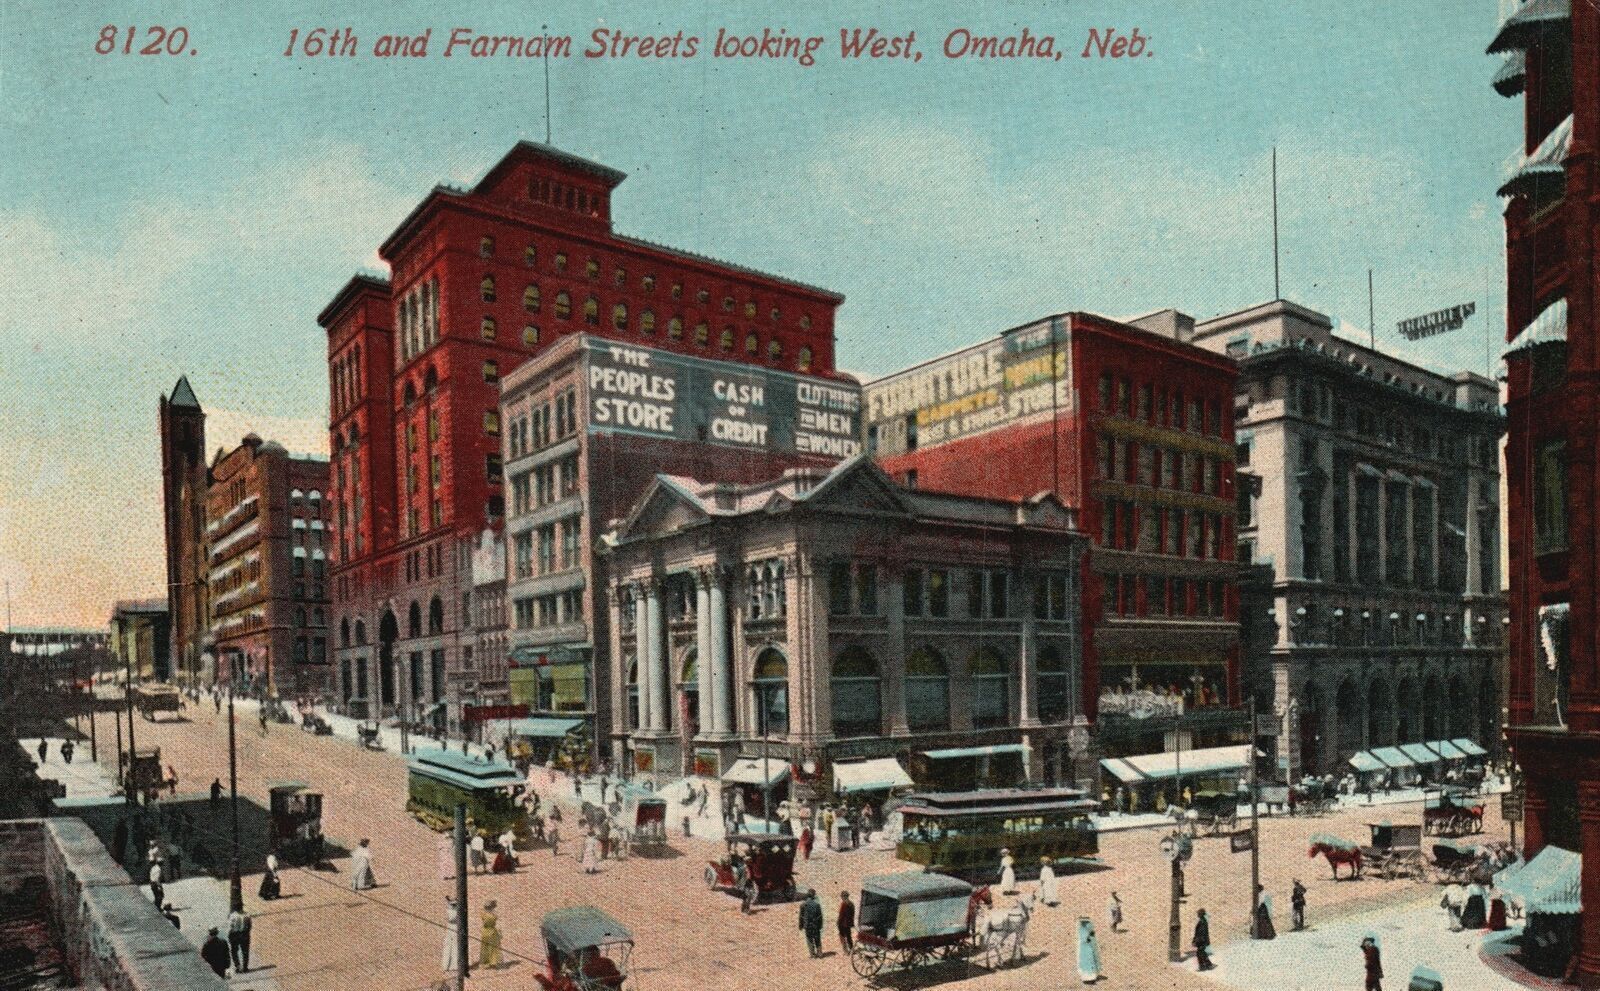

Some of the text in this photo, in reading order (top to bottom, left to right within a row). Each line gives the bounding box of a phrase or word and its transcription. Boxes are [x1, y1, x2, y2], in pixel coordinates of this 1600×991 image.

[609, 346, 651, 368] THE
[589, 365, 676, 401] PEOPLES
[713, 380, 764, 406] CASH
[868, 347, 1004, 422] FURNITURE
[1009, 378, 1070, 418] STORE
[595, 397, 675, 432] STORE
[816, 410, 851, 435] MEN
[711, 417, 768, 445] CREDIT
